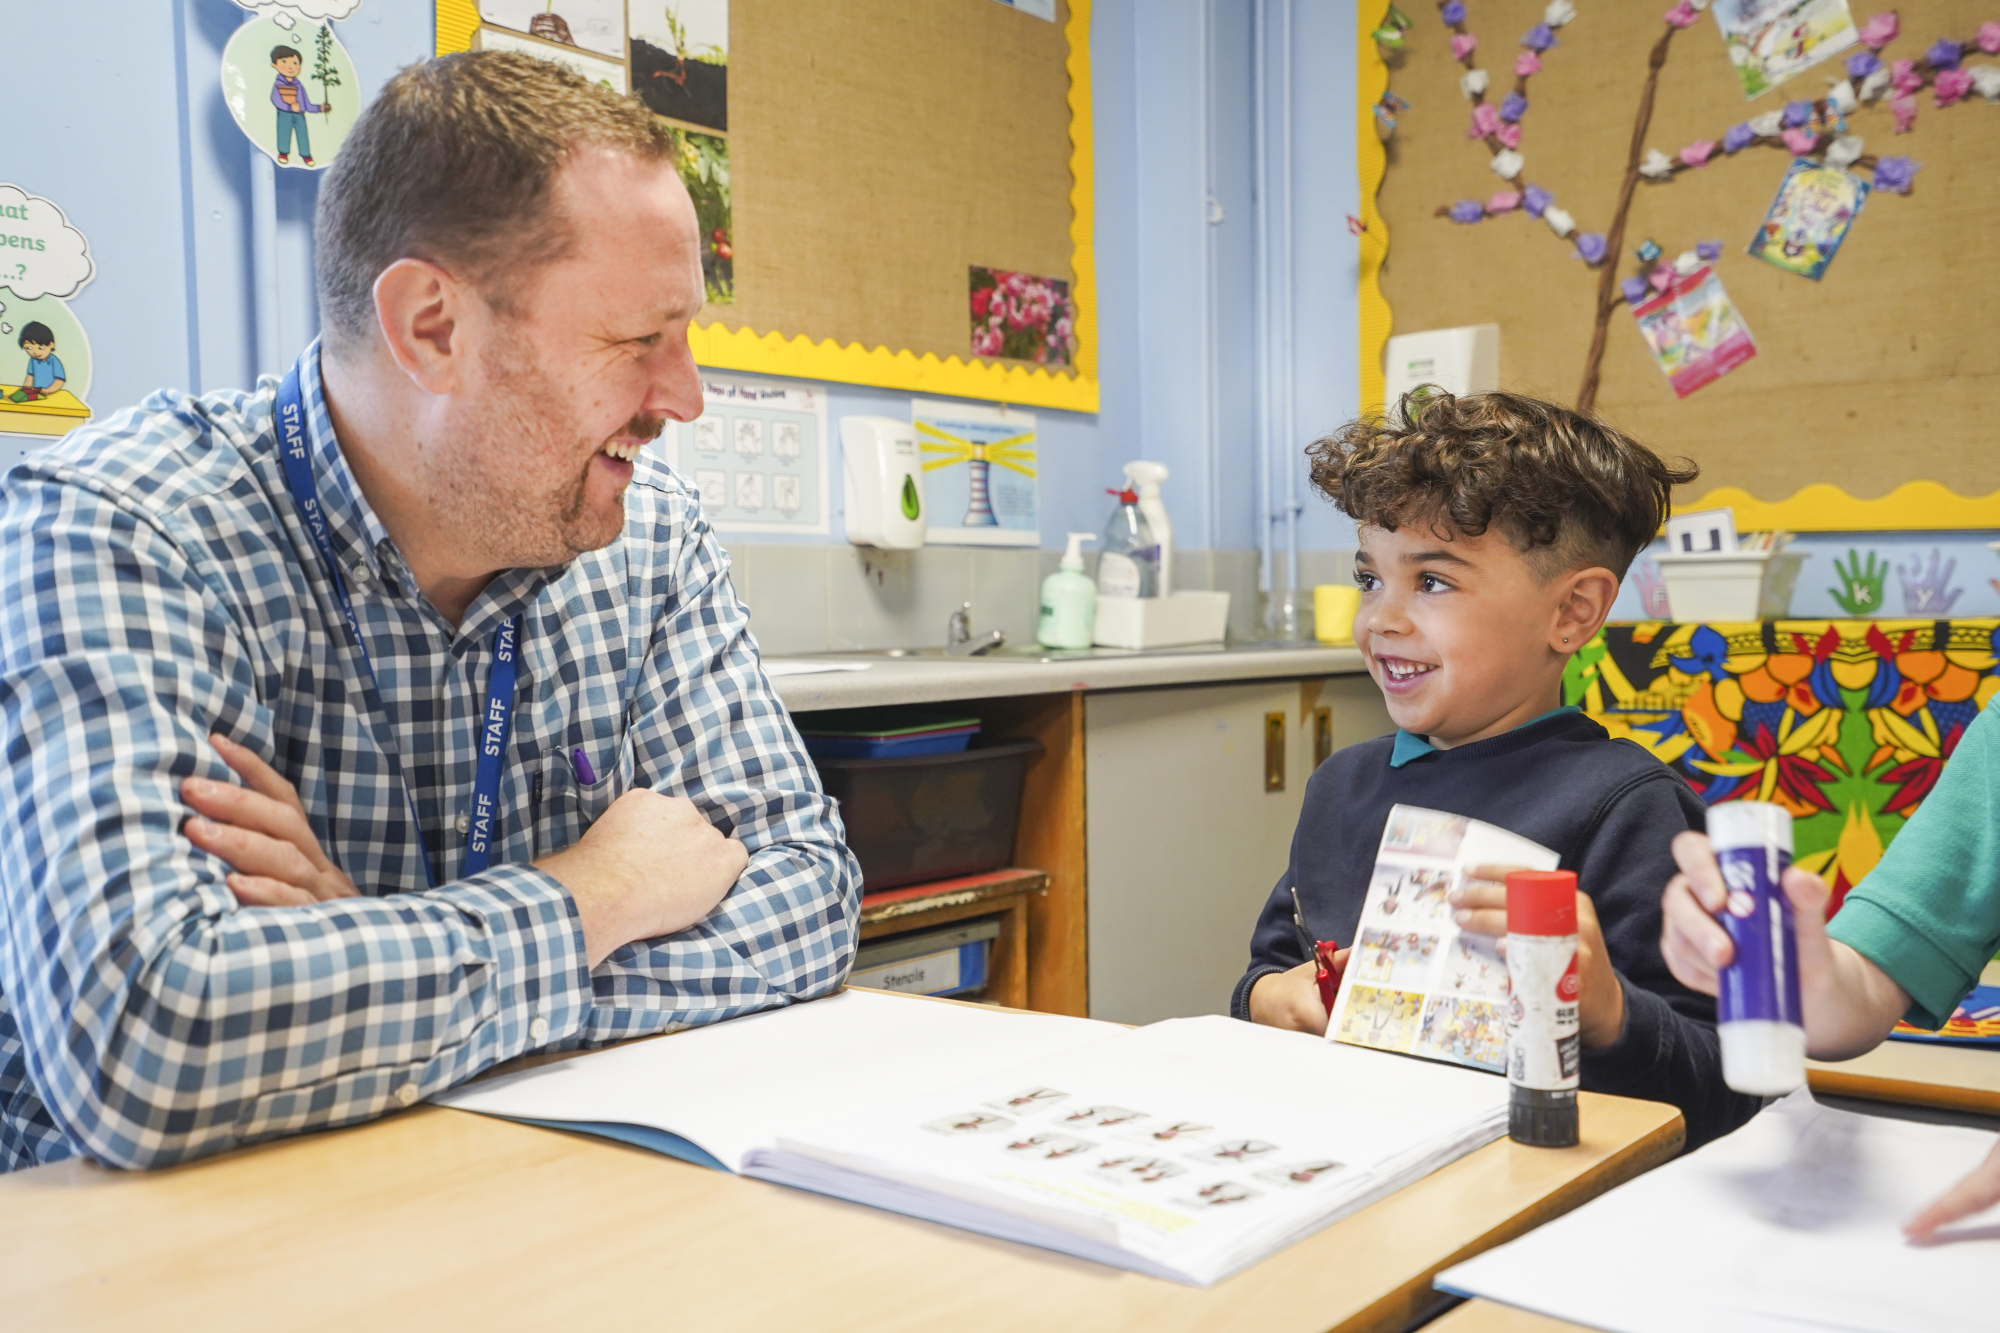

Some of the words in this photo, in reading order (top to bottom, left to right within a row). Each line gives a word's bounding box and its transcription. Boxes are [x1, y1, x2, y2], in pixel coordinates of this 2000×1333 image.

[282, 402, 306, 460] STAFF
[484, 698, 506, 757] STAFF
[472, 793, 492, 853] STAFF
[883, 968, 925, 990] Stencils
